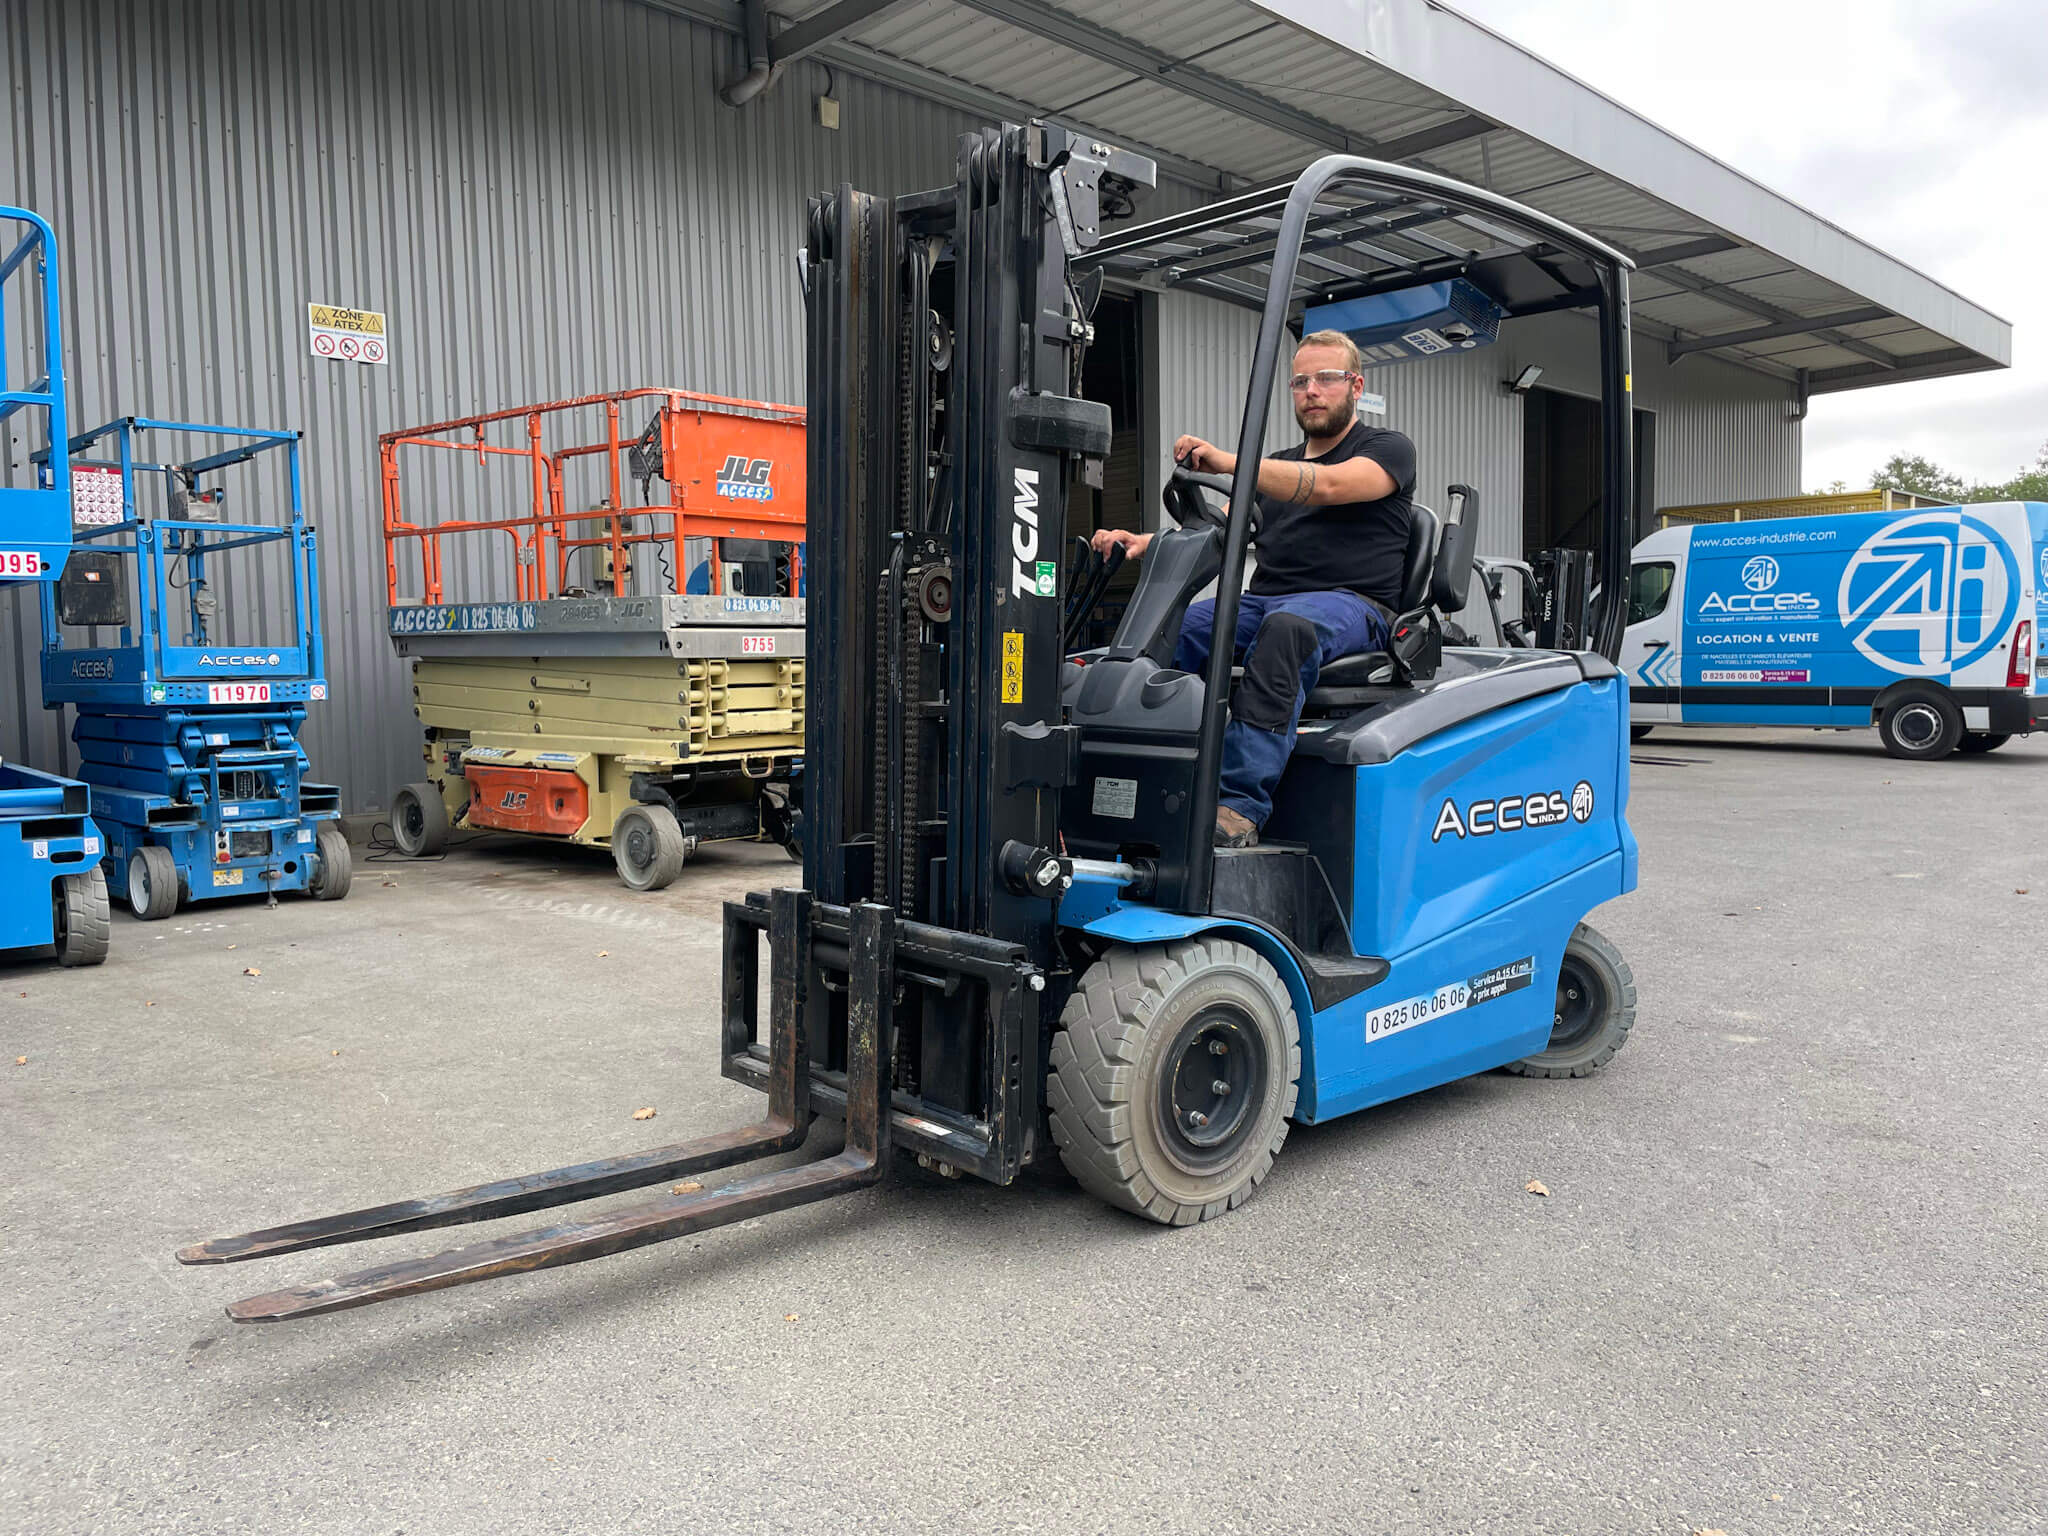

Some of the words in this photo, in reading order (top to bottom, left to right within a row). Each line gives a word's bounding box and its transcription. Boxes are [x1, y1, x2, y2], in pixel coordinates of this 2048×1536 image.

[332, 309, 364, 321] ZONE
[334, 320, 363, 332] ATEX
[716, 455, 772, 486] JLG
[1012, 467, 1039, 599] TCM
[1692, 530, 1837, 548] www.acces-industrie.com
[621, 602, 645, 618] JLG
[1544, 590, 1552, 622] TOYOTA
[1699, 591, 1820, 613] Acces
[462, 610, 469, 628] 0
[471, 608, 488, 629] 825
[507, 605, 519, 628] 06
[522, 604, 535, 628] 06
[743, 637, 774, 652] 8755
[1696, 633, 1762, 645] LOCATION
[1766, 634, 1775, 643] &
[1779, 632, 1820, 643] VENTE
[199, 654, 267, 666] Acces
[71, 658, 107, 680] Acces
[1709, 672, 1724, 680] 825
[212, 685, 268, 702] 11970
[1432, 791, 1569, 843] Acces
[1538, 814, 1557, 824] IND.
[1473, 973, 1496, 989] Service
[1490, 979, 1507, 997] appel
[1371, 1016, 1379, 1034] 0
[1383, 1007, 1408, 1030] 825
[1412, 1002, 1427, 1020] 06
[1431, 993, 1446, 1013] 06
[1450, 987, 1465, 1006] 06
